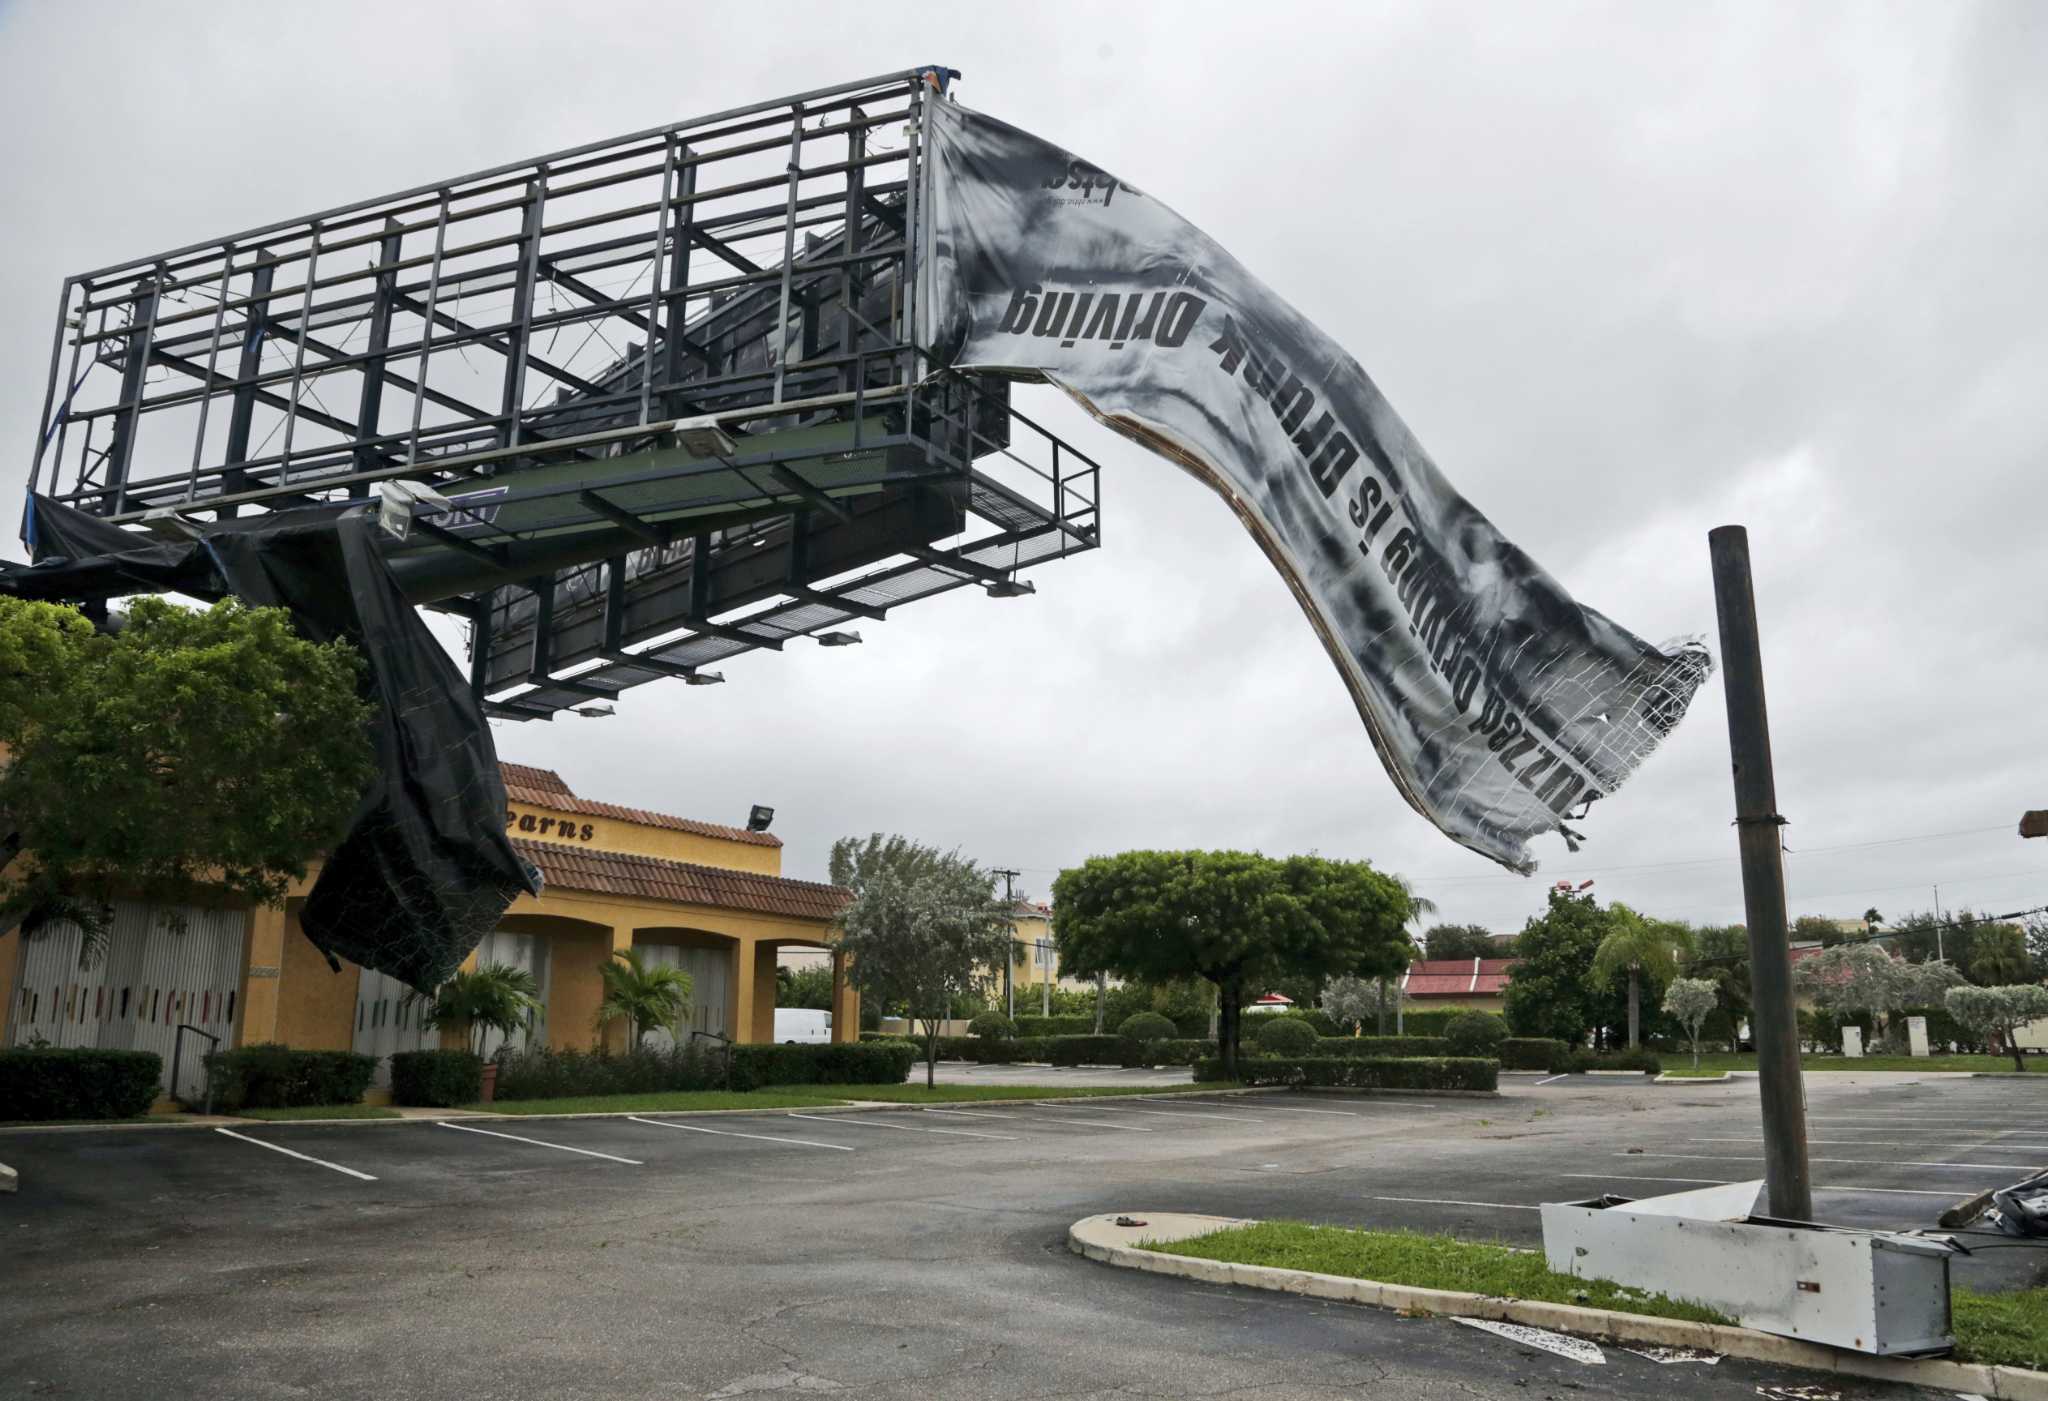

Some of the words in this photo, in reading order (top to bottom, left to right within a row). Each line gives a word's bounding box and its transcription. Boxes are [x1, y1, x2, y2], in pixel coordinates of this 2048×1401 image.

[997, 283, 1208, 350] Driving
[1208, 313, 1361, 499] Drunk
[1348, 476, 1394, 556] is
[1380, 527, 1482, 715] Driving
[1467, 687, 1590, 817] uzzed
